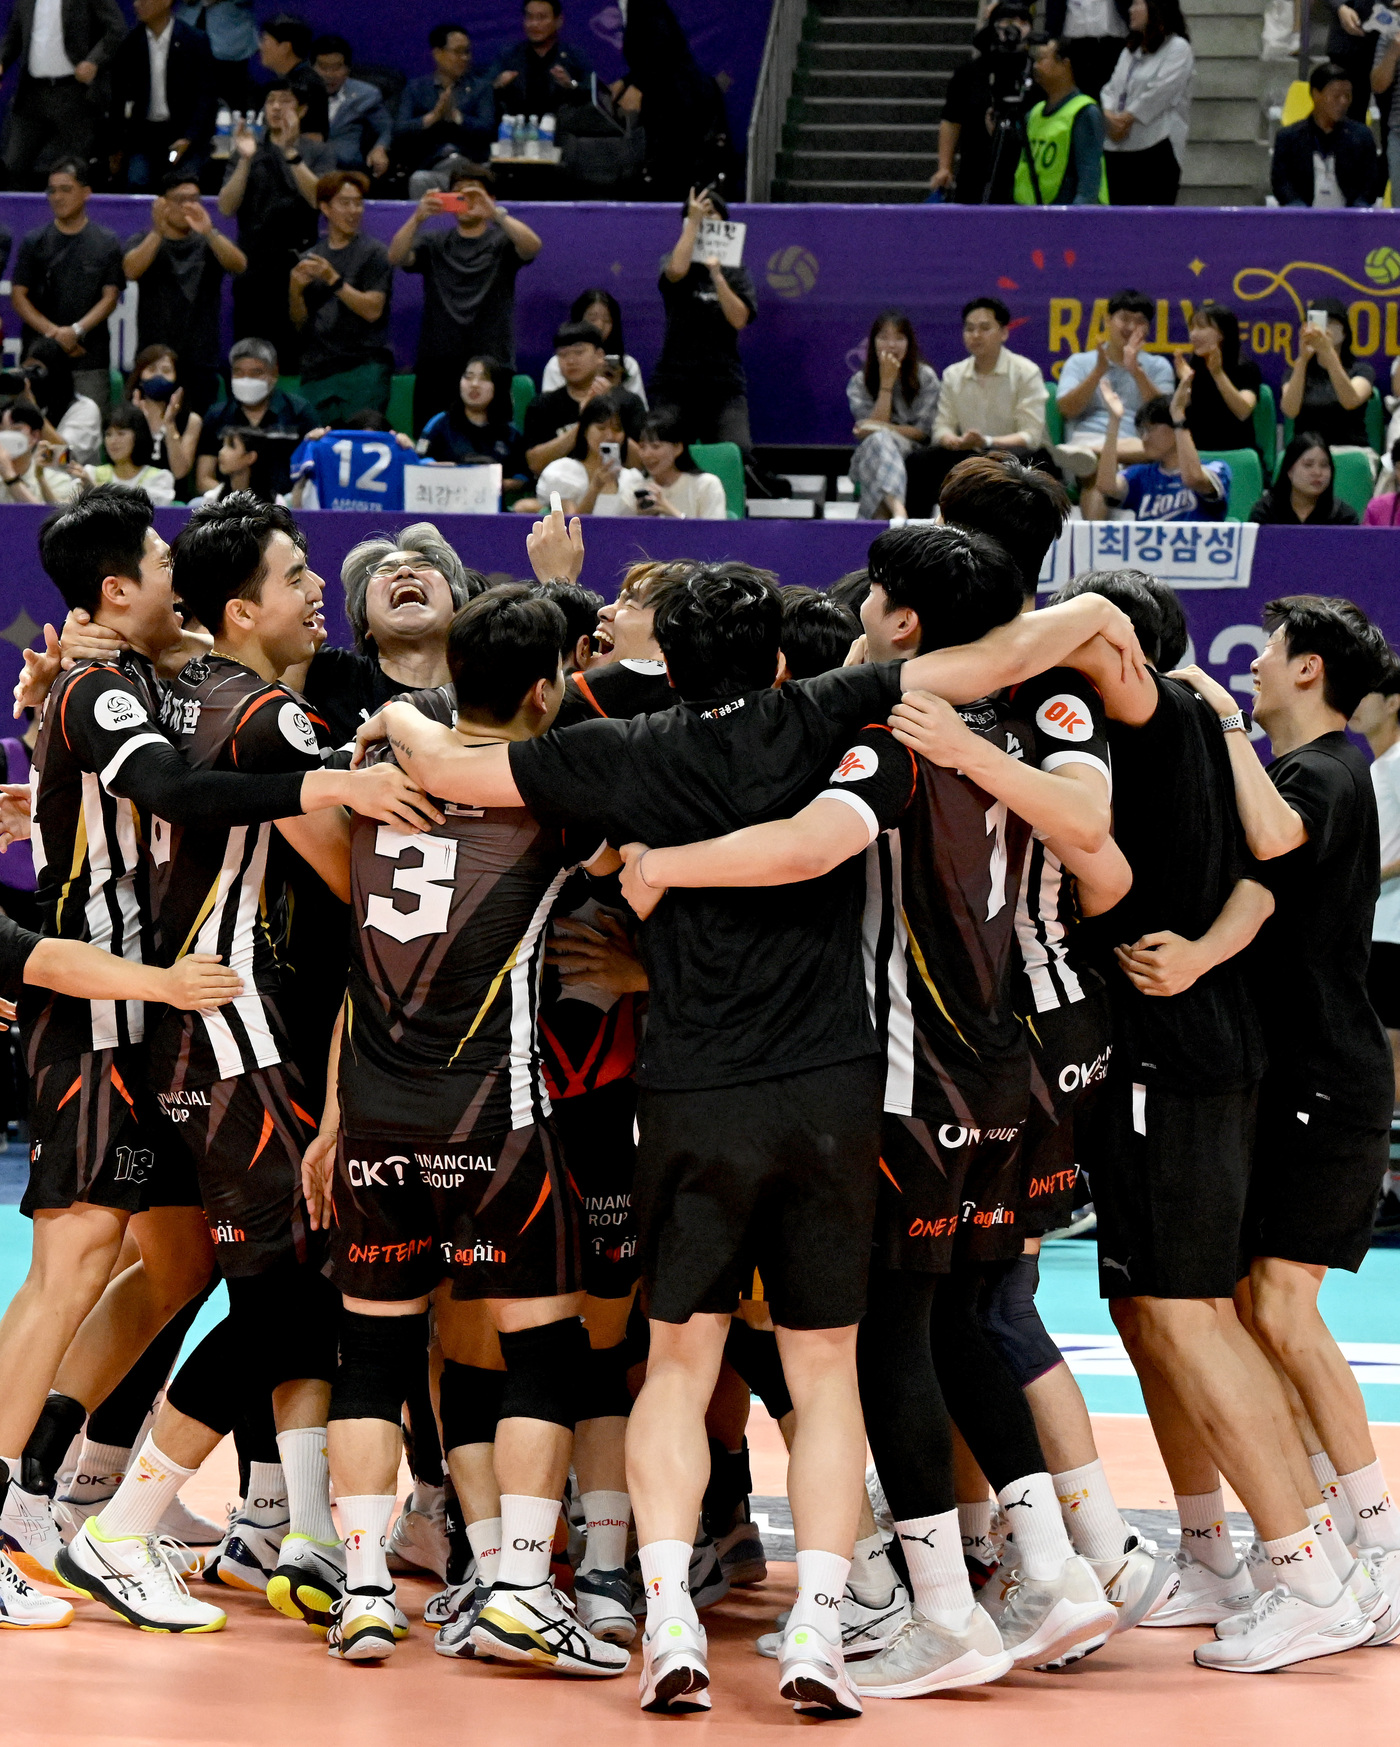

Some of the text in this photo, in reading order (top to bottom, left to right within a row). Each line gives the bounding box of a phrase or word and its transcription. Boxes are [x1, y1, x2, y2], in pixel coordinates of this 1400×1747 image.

[332, 439, 392, 492] 12
[1097, 524, 1235, 564] 최강삼성
[1044, 701, 1086, 735] OK
[362, 825, 458, 944] 3
